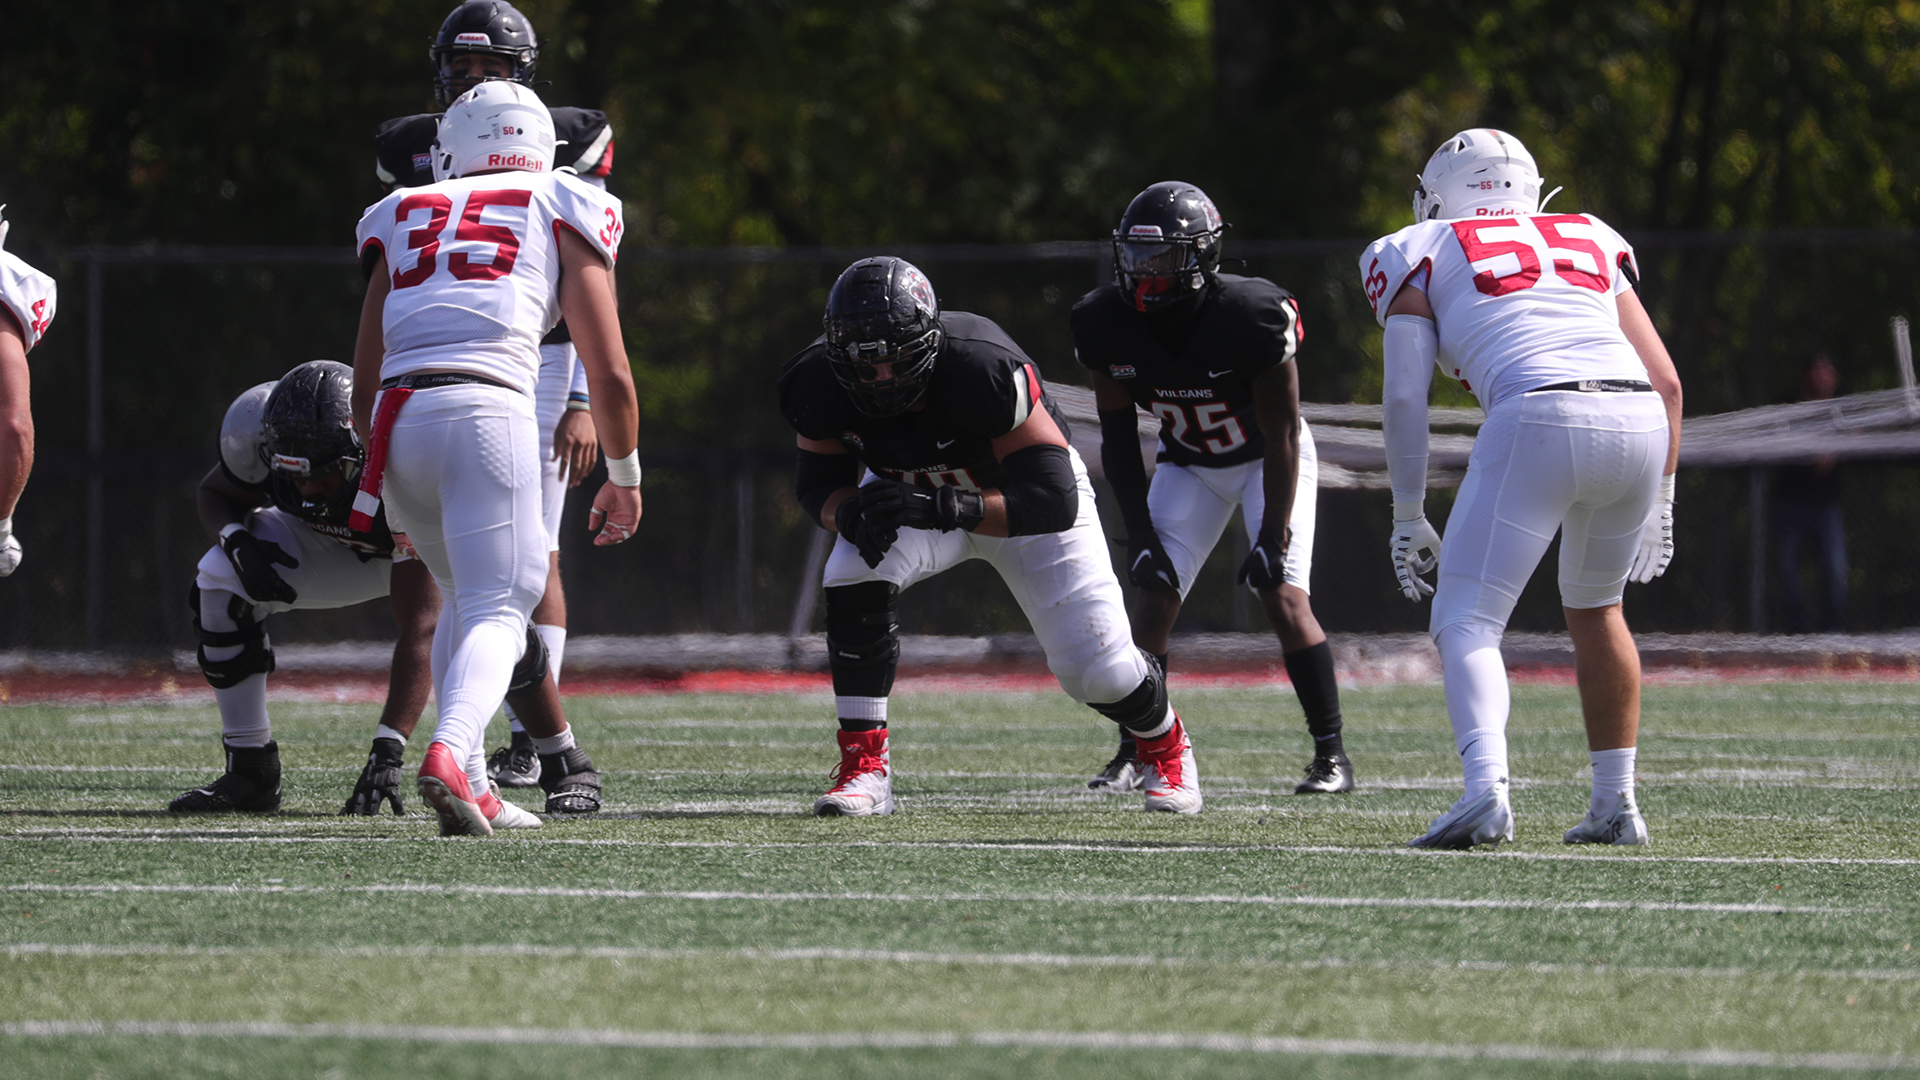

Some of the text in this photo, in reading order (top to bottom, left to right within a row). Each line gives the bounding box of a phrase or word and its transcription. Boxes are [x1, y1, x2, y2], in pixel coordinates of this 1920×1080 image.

[502, 125, 515, 135] 50
[488, 154, 543, 172] Riddell
[1480, 180, 1492, 190] 55
[393, 189, 533, 290] 35
[1450, 213, 1612, 297] 55
[1154, 387, 1214, 398] VULCANS
[1150, 401, 1248, 455] 25
